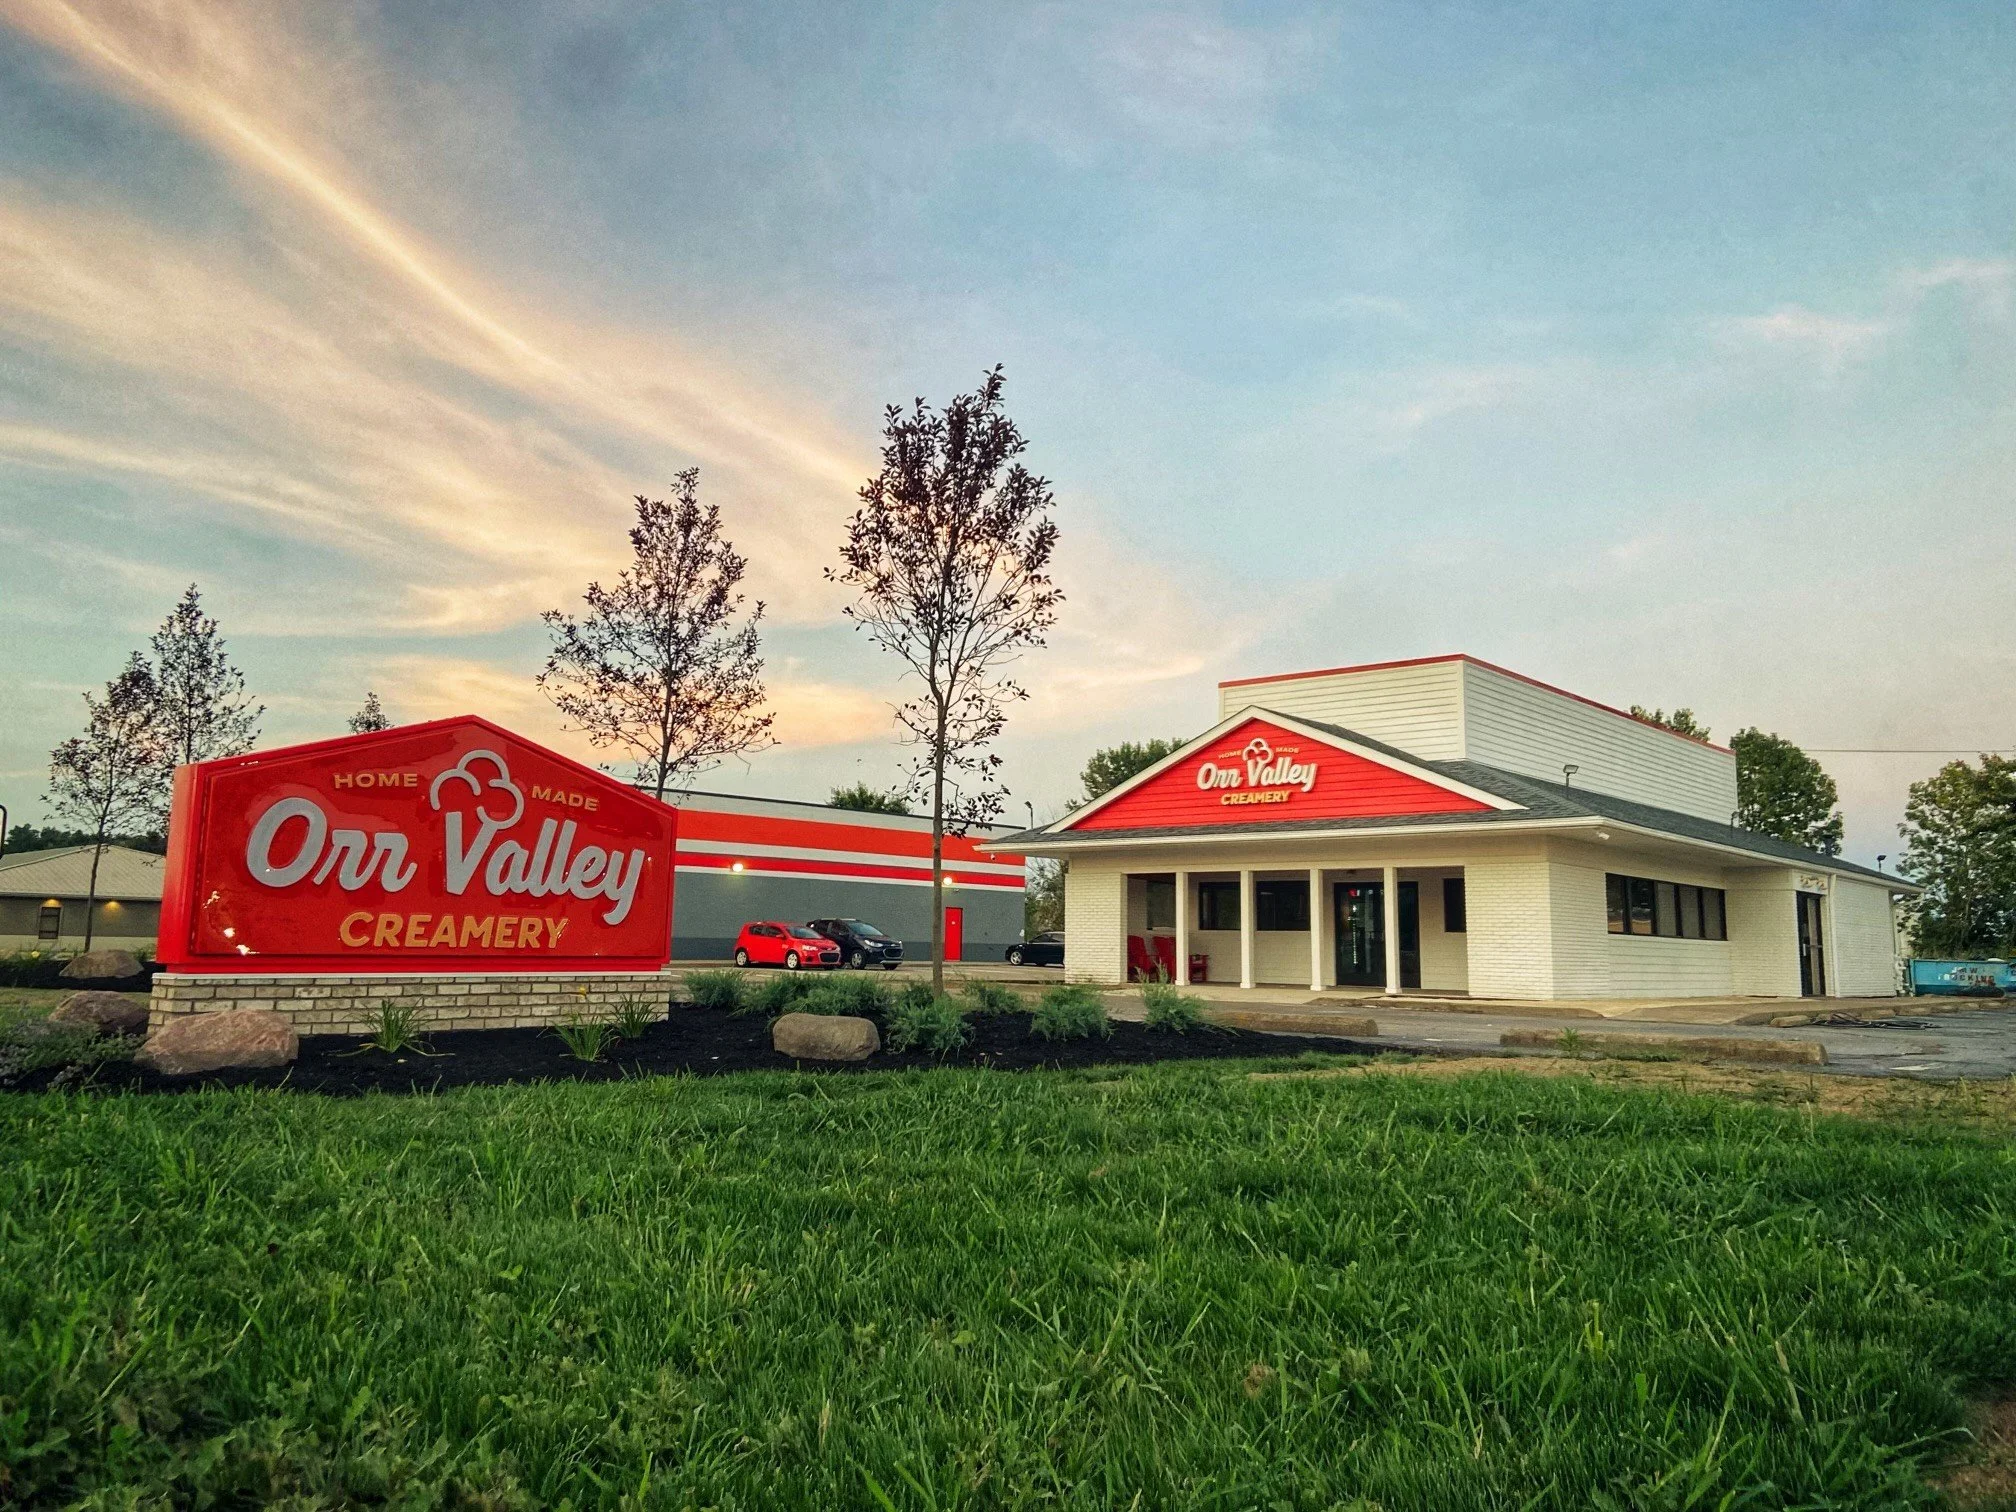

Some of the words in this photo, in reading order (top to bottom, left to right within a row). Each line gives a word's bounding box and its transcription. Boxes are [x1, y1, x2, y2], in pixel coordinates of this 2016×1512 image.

[1218, 750, 1242, 759] HOME
[334, 772, 418, 789] HOME
[531, 786, 598, 811] MADE
[1197, 762, 1243, 790] Orr
[1247, 757, 1317, 792] Valley
[1220, 791, 1291, 805] CREAMERY
[247, 797, 418, 893] Orr
[444, 811, 646, 926] Valley
[340, 911, 568, 949] CREAMERY
